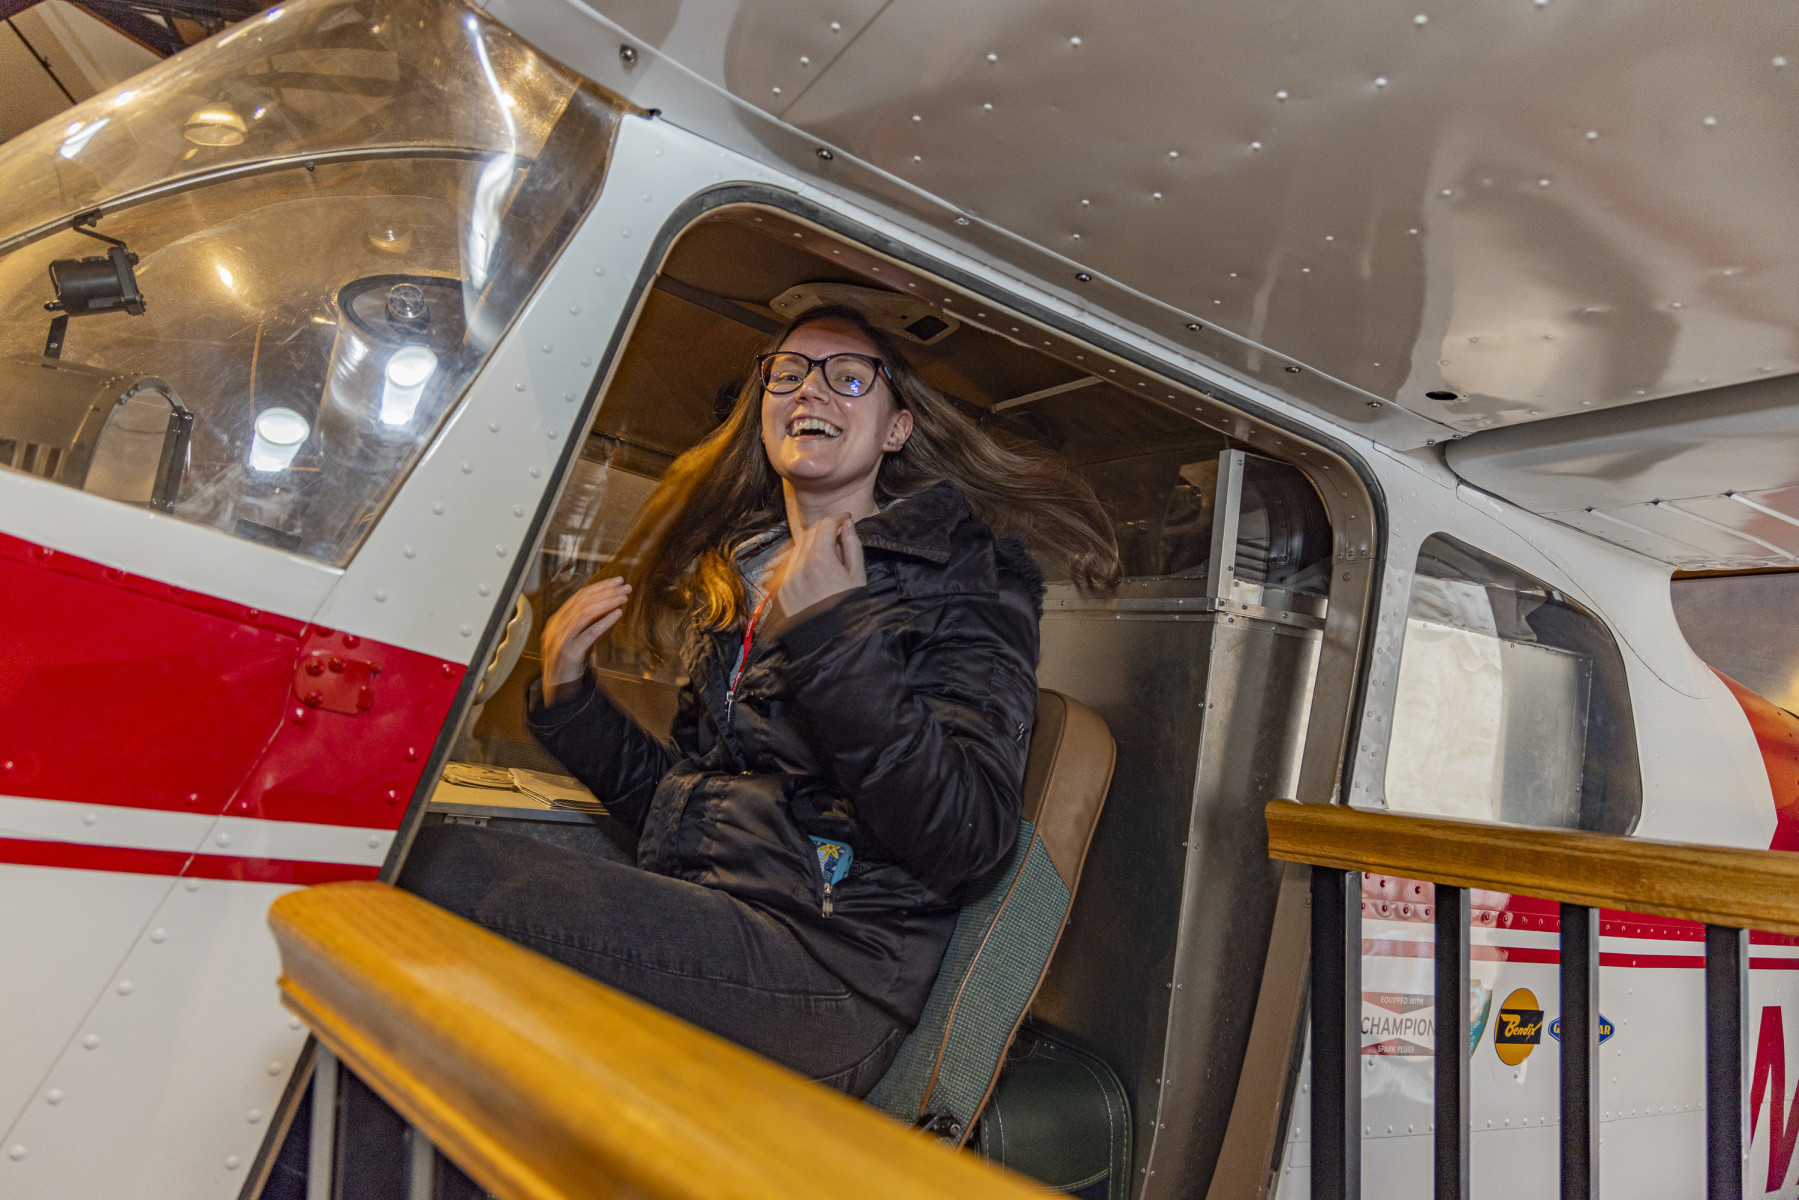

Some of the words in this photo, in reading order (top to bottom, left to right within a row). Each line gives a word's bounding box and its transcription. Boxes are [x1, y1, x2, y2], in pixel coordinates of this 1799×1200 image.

[1380, 995, 1408, 1005] EQUIPPED
[1409, 997, 1424, 1006] WITH
[1361, 1016, 1435, 1037] CHAMPION
[1500, 1013, 1543, 1041] Bendix
[1377, 1045, 1396, 1053] SPARK
[1397, 1046, 1415, 1054] PLUGS
